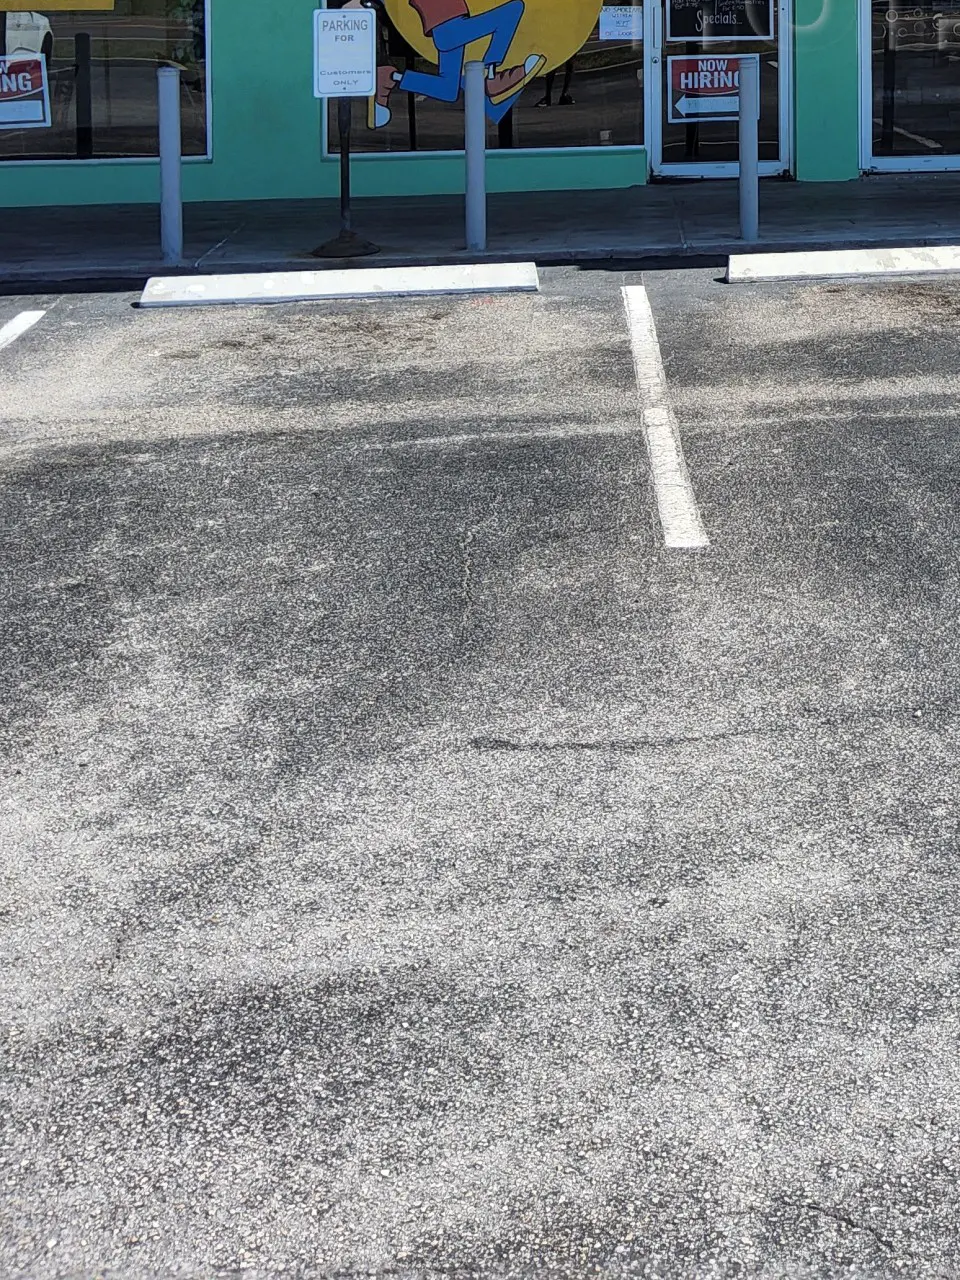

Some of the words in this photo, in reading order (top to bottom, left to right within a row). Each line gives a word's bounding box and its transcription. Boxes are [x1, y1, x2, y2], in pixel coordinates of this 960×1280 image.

[322, 19, 369, 32] PARKING
[334, 34, 355, 42] FOR
[698, 59, 728, 72] NOW
[332, 79, 359, 87] ONLY
